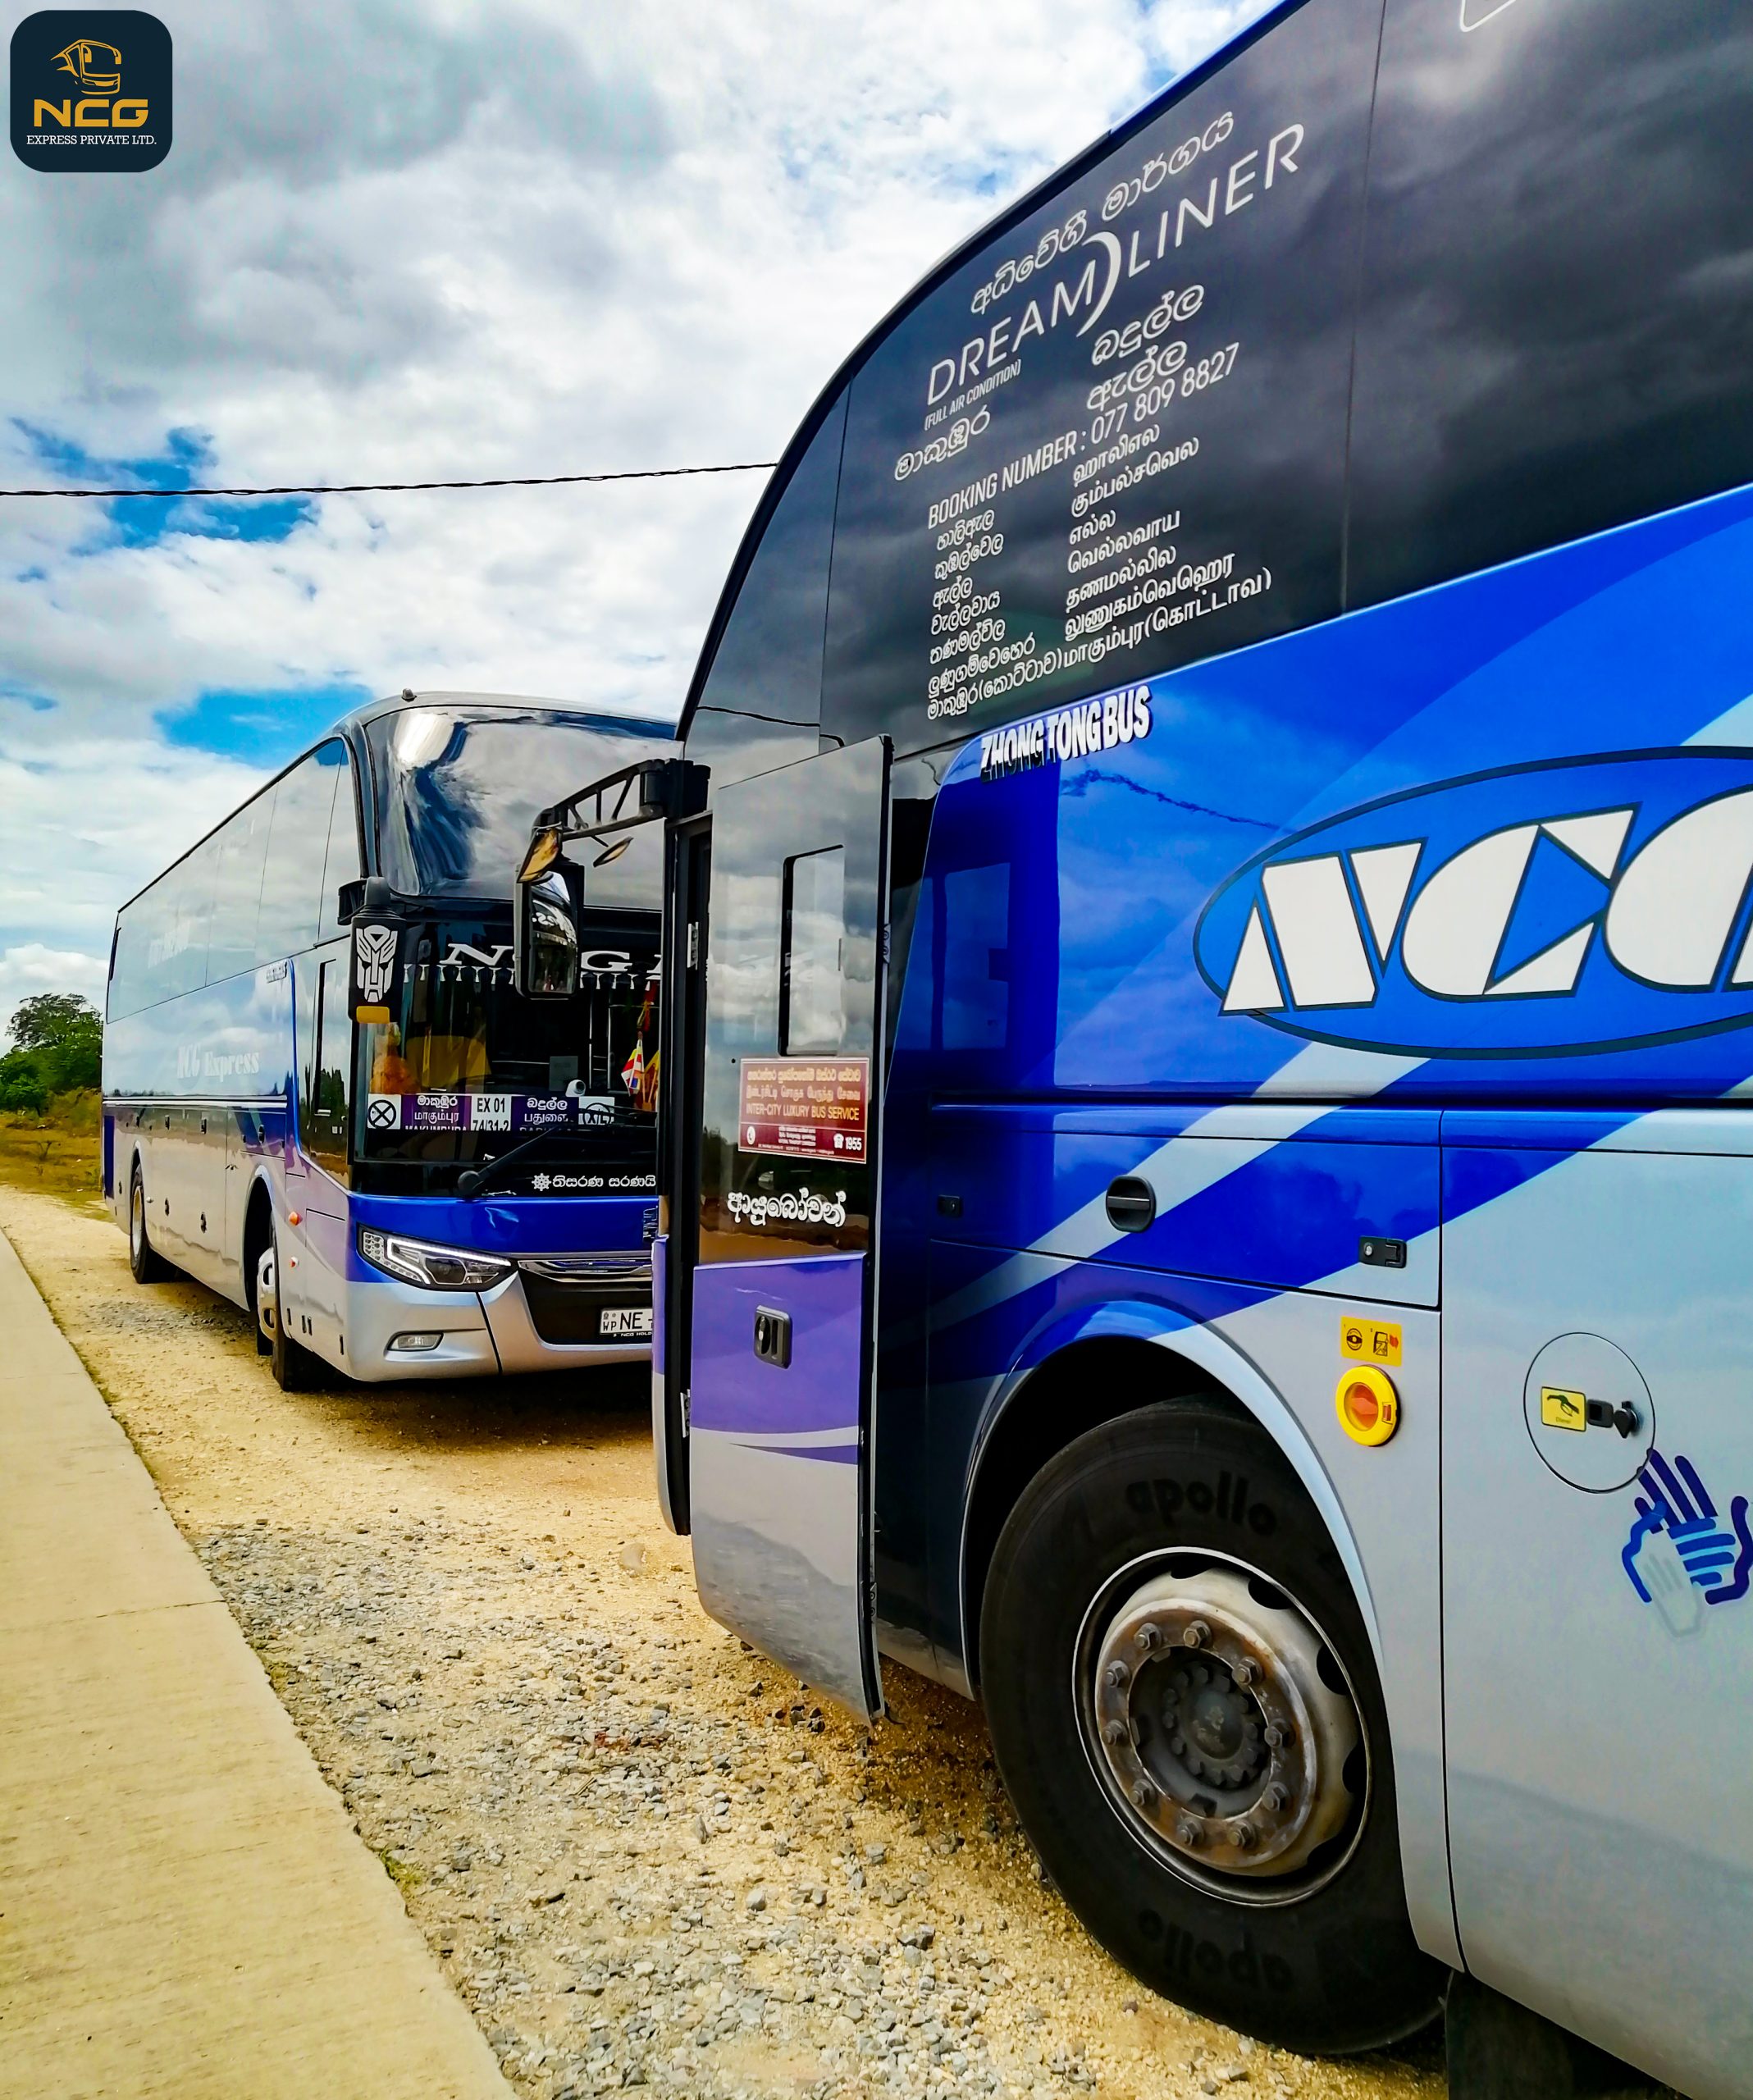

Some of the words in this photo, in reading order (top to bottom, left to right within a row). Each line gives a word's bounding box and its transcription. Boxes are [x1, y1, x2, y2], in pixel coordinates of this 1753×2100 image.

[927, 259, 1097, 406] DREAM
[1129, 123, 1305, 278] LINER
[1092, 285, 1205, 366] බදුල්ල
[924, 405, 948, 431] (FULL
[949, 395, 966, 416] AIR
[966, 358, 1021, 404] CONDITION)
[1087, 340, 1188, 412] ඇල්ල
[928, 472, 998, 529] BOOKING
[1002, 430, 1078, 492] NUMBER
[1091, 401, 1127, 444] 077
[1133, 381, 1176, 422] 809
[1180, 341, 1240, 409] 8827
[1073, 424, 1160, 488] ஹாலிஎல
[1067, 510, 1180, 574] வெல்லவாய
[1070, 509, 1116, 545] எல்ல
[931, 591, 1001, 635] වැල්ලවාය
[933, 575, 973, 610] ඇල්ල
[979, 719, 1044, 782] ZHONG
[1047, 699, 1101, 762] TONG
[1102, 684, 1153, 743] BUS
[477, 1098, 491, 1112] EX
[494, 1098, 505, 1112] 01
[746, 1102, 782, 1116] INTER-CITY
[783, 1104, 810, 1118] LUXURY
[811, 1106, 826, 1119] BUS
[828, 1106, 860, 1121] SERVICE
[845, 1136, 862, 1151] 1955
[1125, 1471, 1277, 1536] apollo
